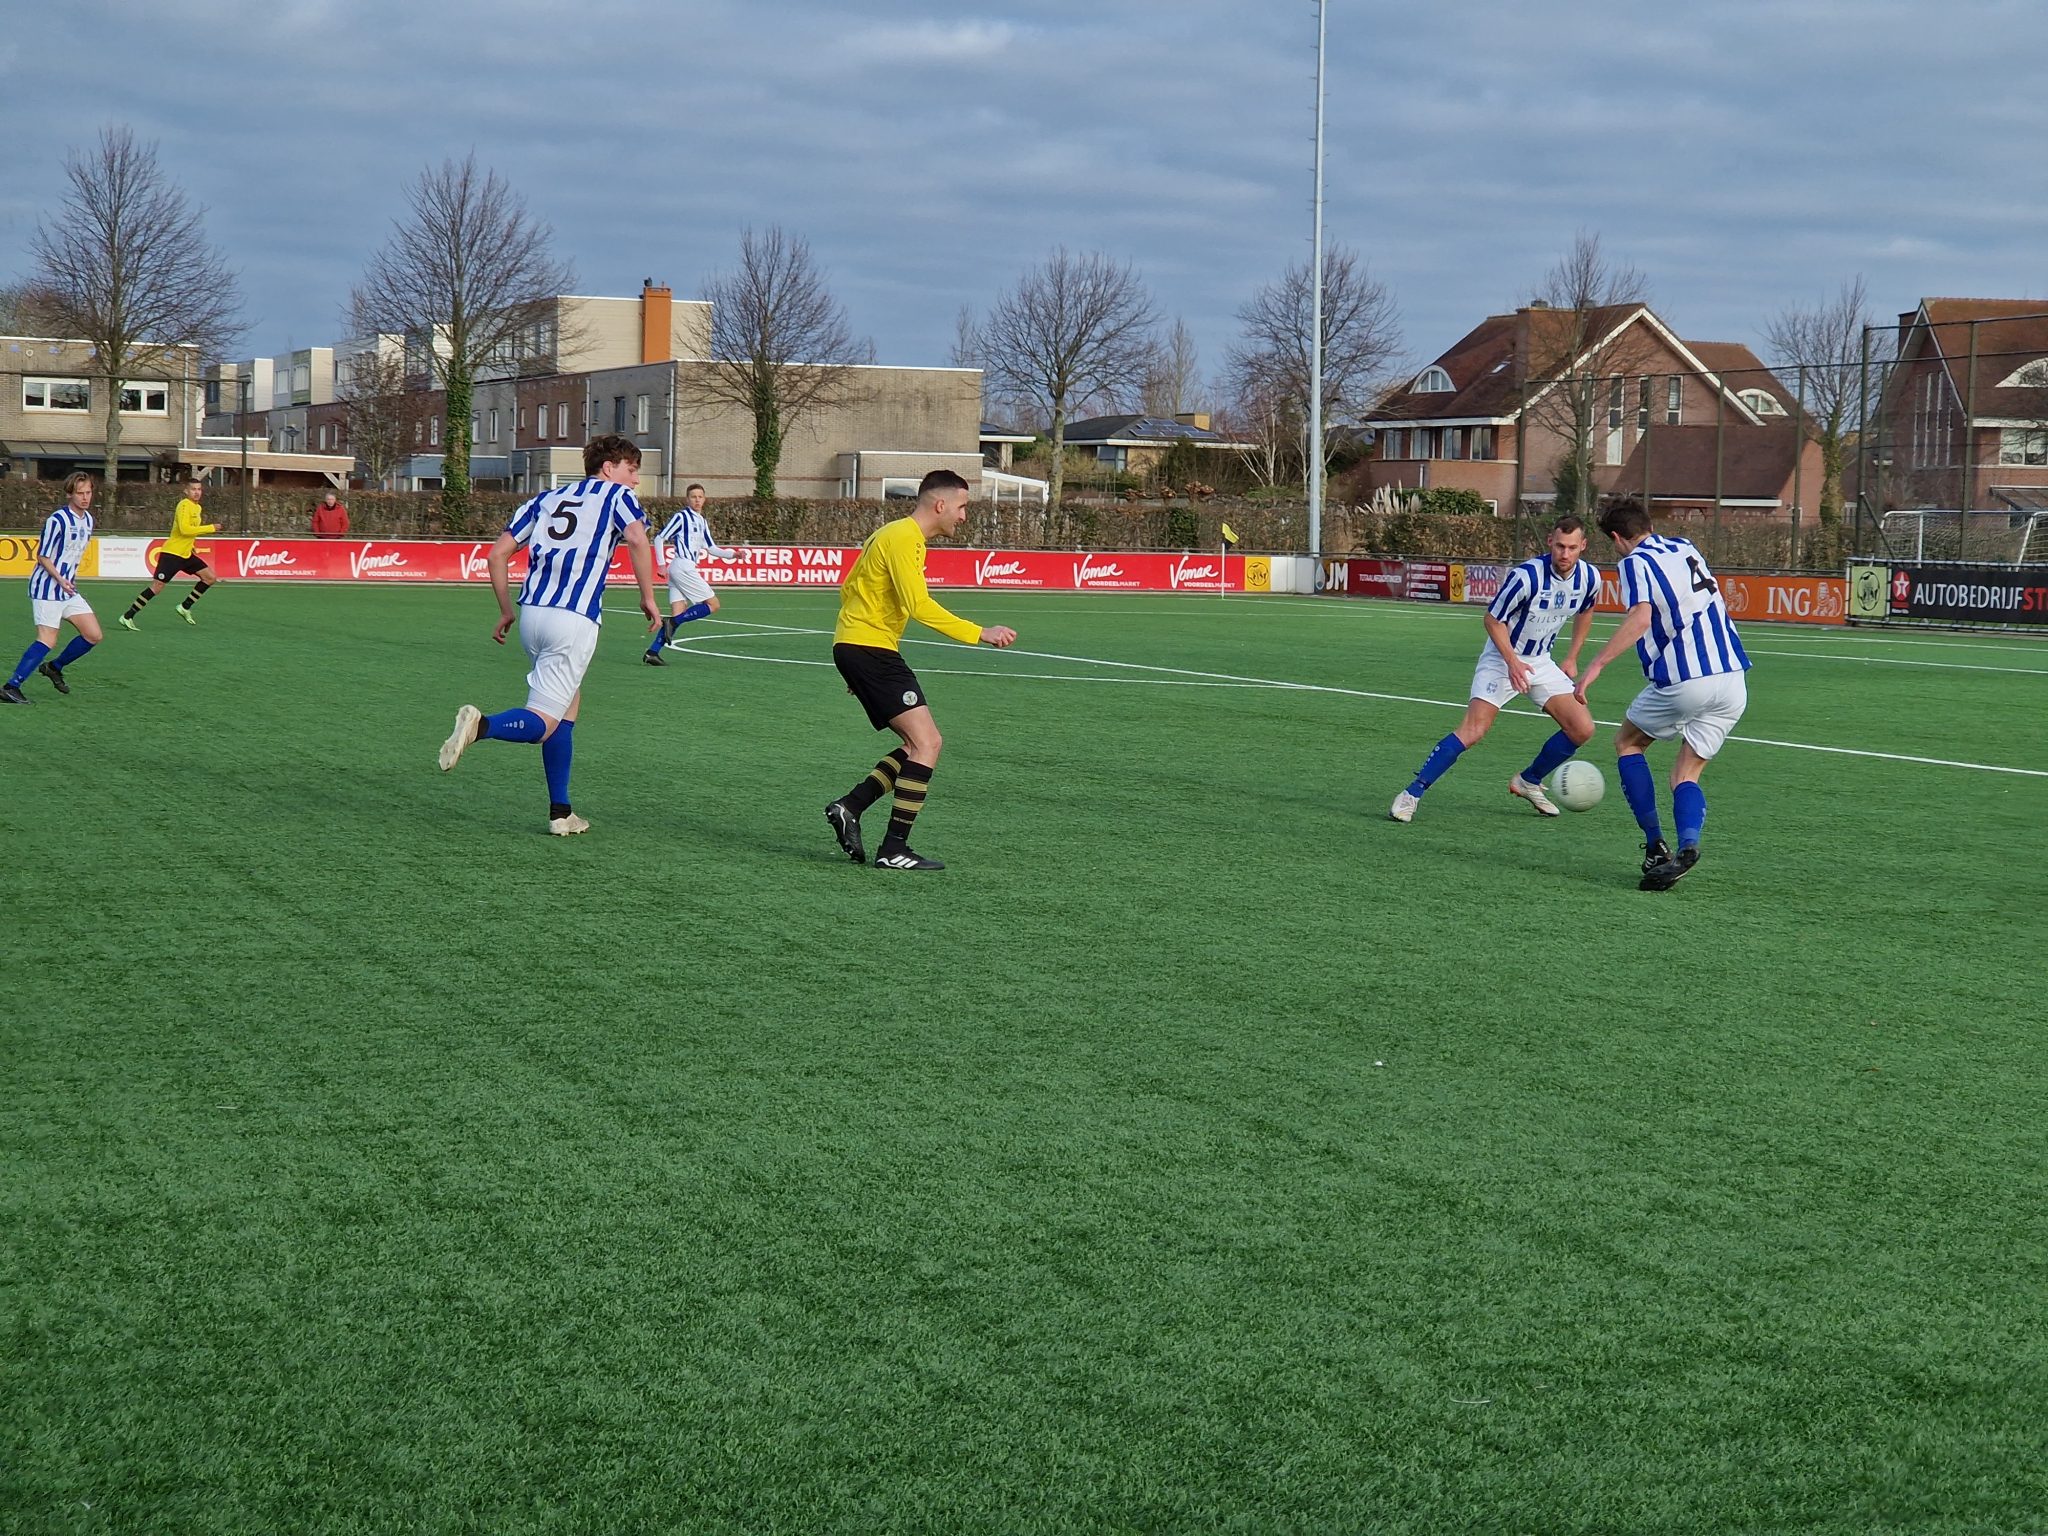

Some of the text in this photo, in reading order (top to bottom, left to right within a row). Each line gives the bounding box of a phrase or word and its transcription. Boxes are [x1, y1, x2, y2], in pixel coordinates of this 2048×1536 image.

[548, 500, 584, 540] 5
[798, 549, 843, 566] VAN
[797, 569, 841, 583] HHW
[1325, 562, 1349, 590] JM
[1469, 566, 1497, 580] KOOS
[1686, 555, 1718, 595] 4
[1597, 580, 1621, 605] IN
[1766, 586, 1811, 616] ING
[1913, 582, 2024, 610] AUTOBEDRIJF
